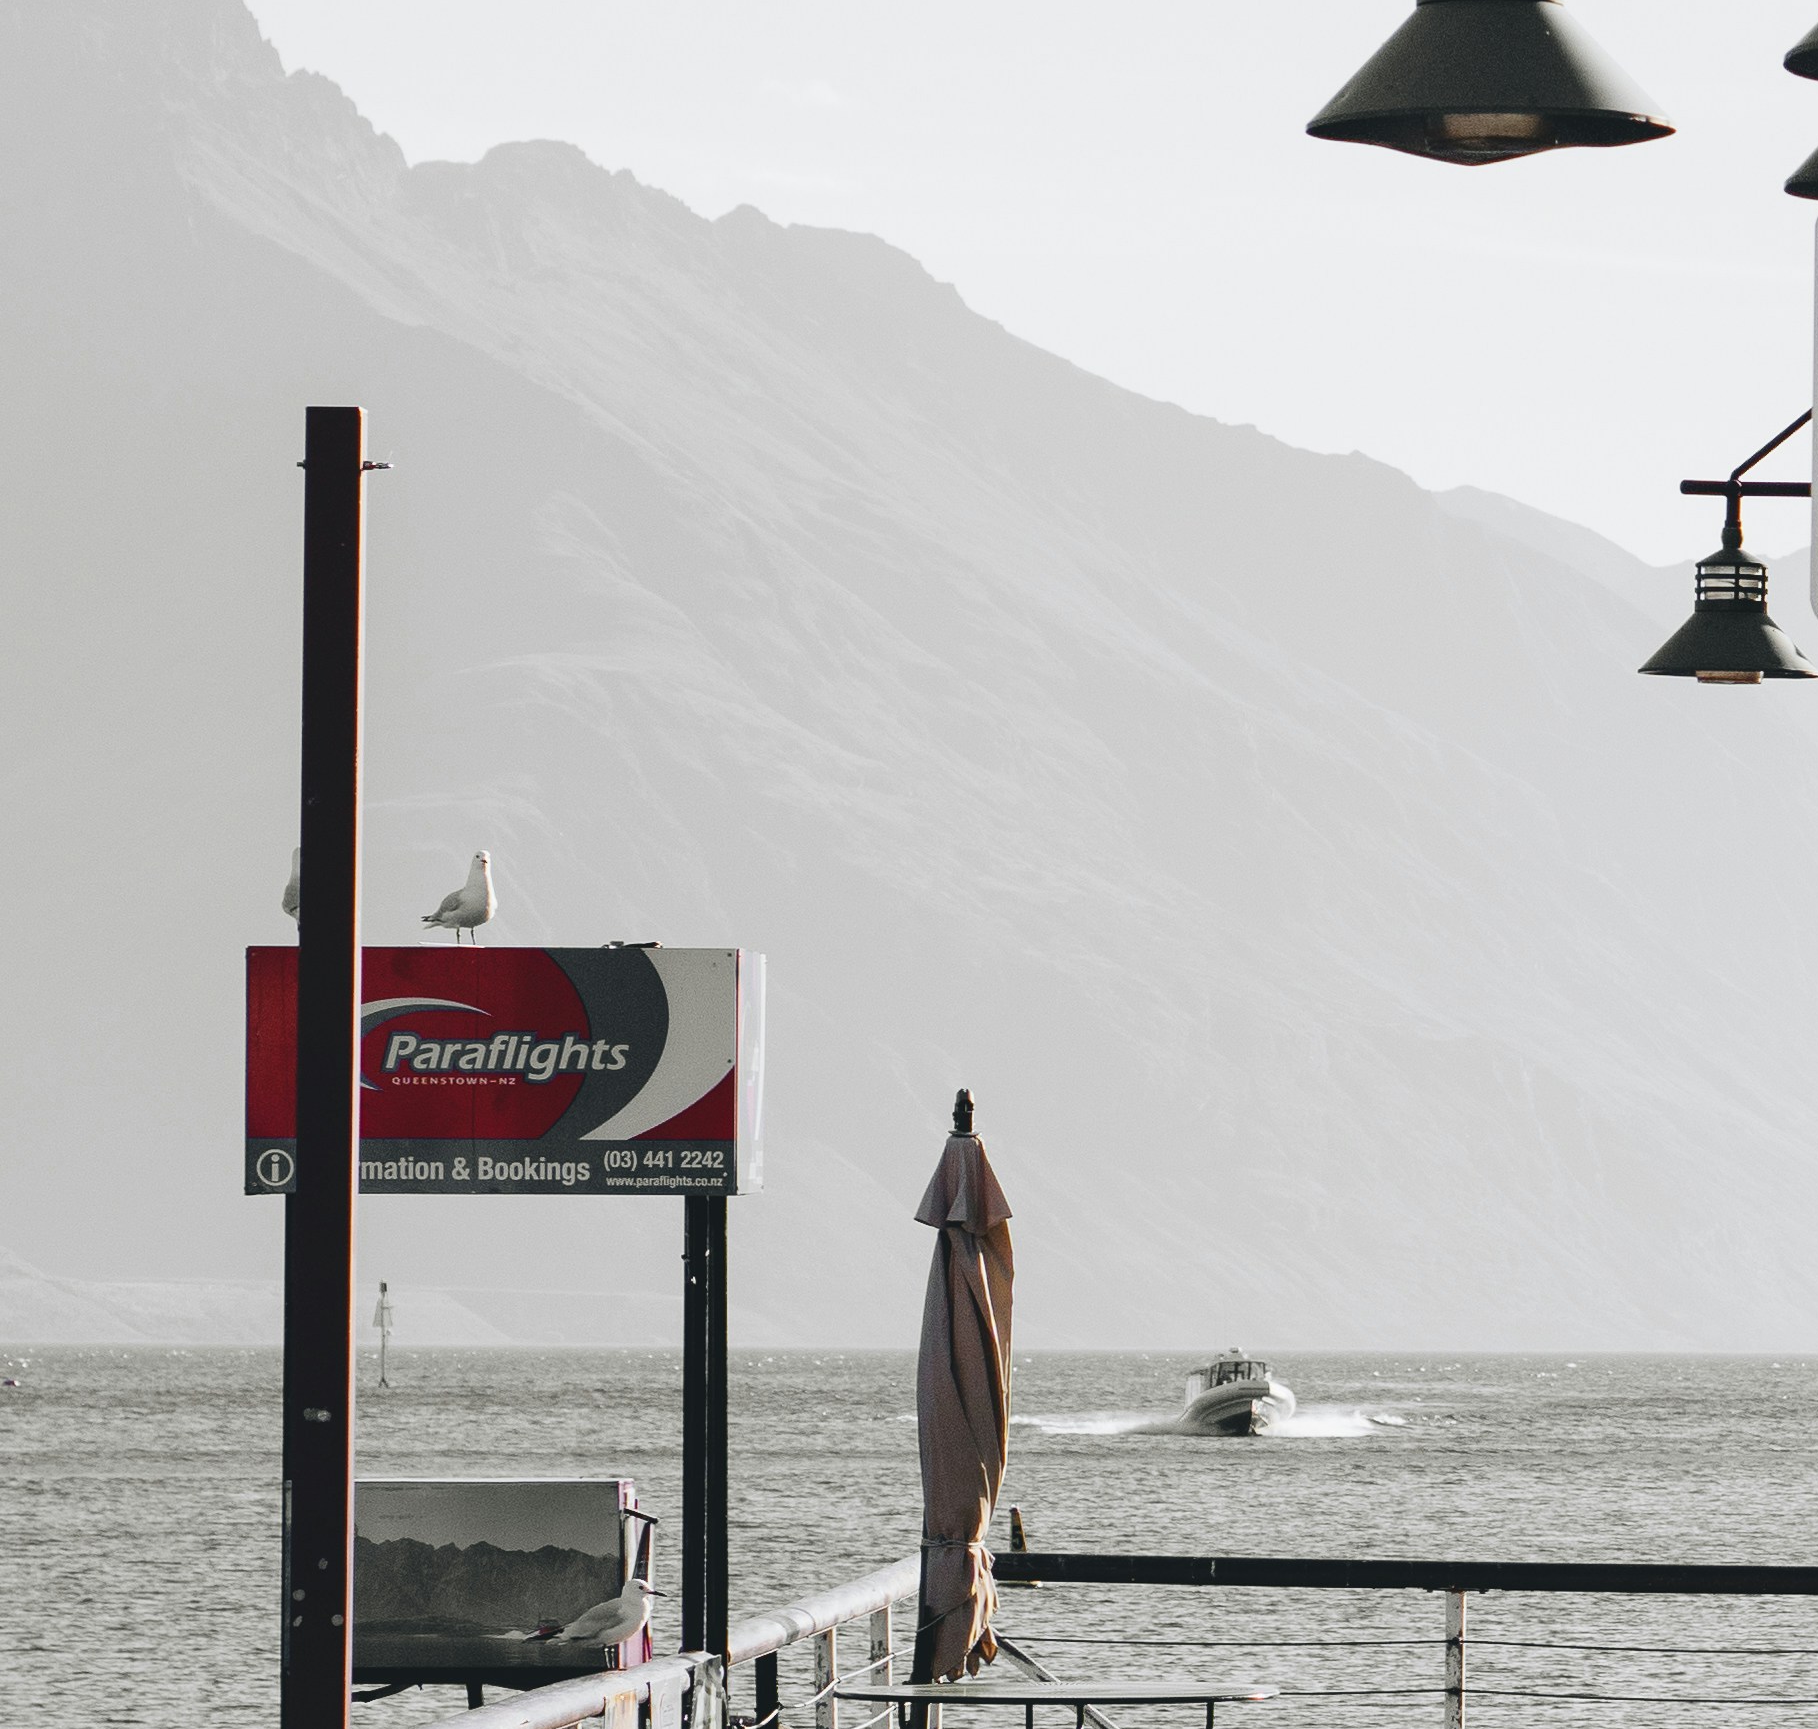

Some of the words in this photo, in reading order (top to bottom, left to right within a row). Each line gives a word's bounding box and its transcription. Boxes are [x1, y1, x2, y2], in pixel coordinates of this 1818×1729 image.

[385, 1034, 630, 1081] Paraflights
[359, 1156, 445, 1180] mation
[451, 1156, 470, 1180] &
[477, 1156, 591, 1186] Bookings
[603, 1150, 638, 1171] (03)
[643, 1150, 673, 1168] 441
[680, 1150, 724, 1168] 2242
[606, 1175, 723, 1188] www.paraflights.co.nz
